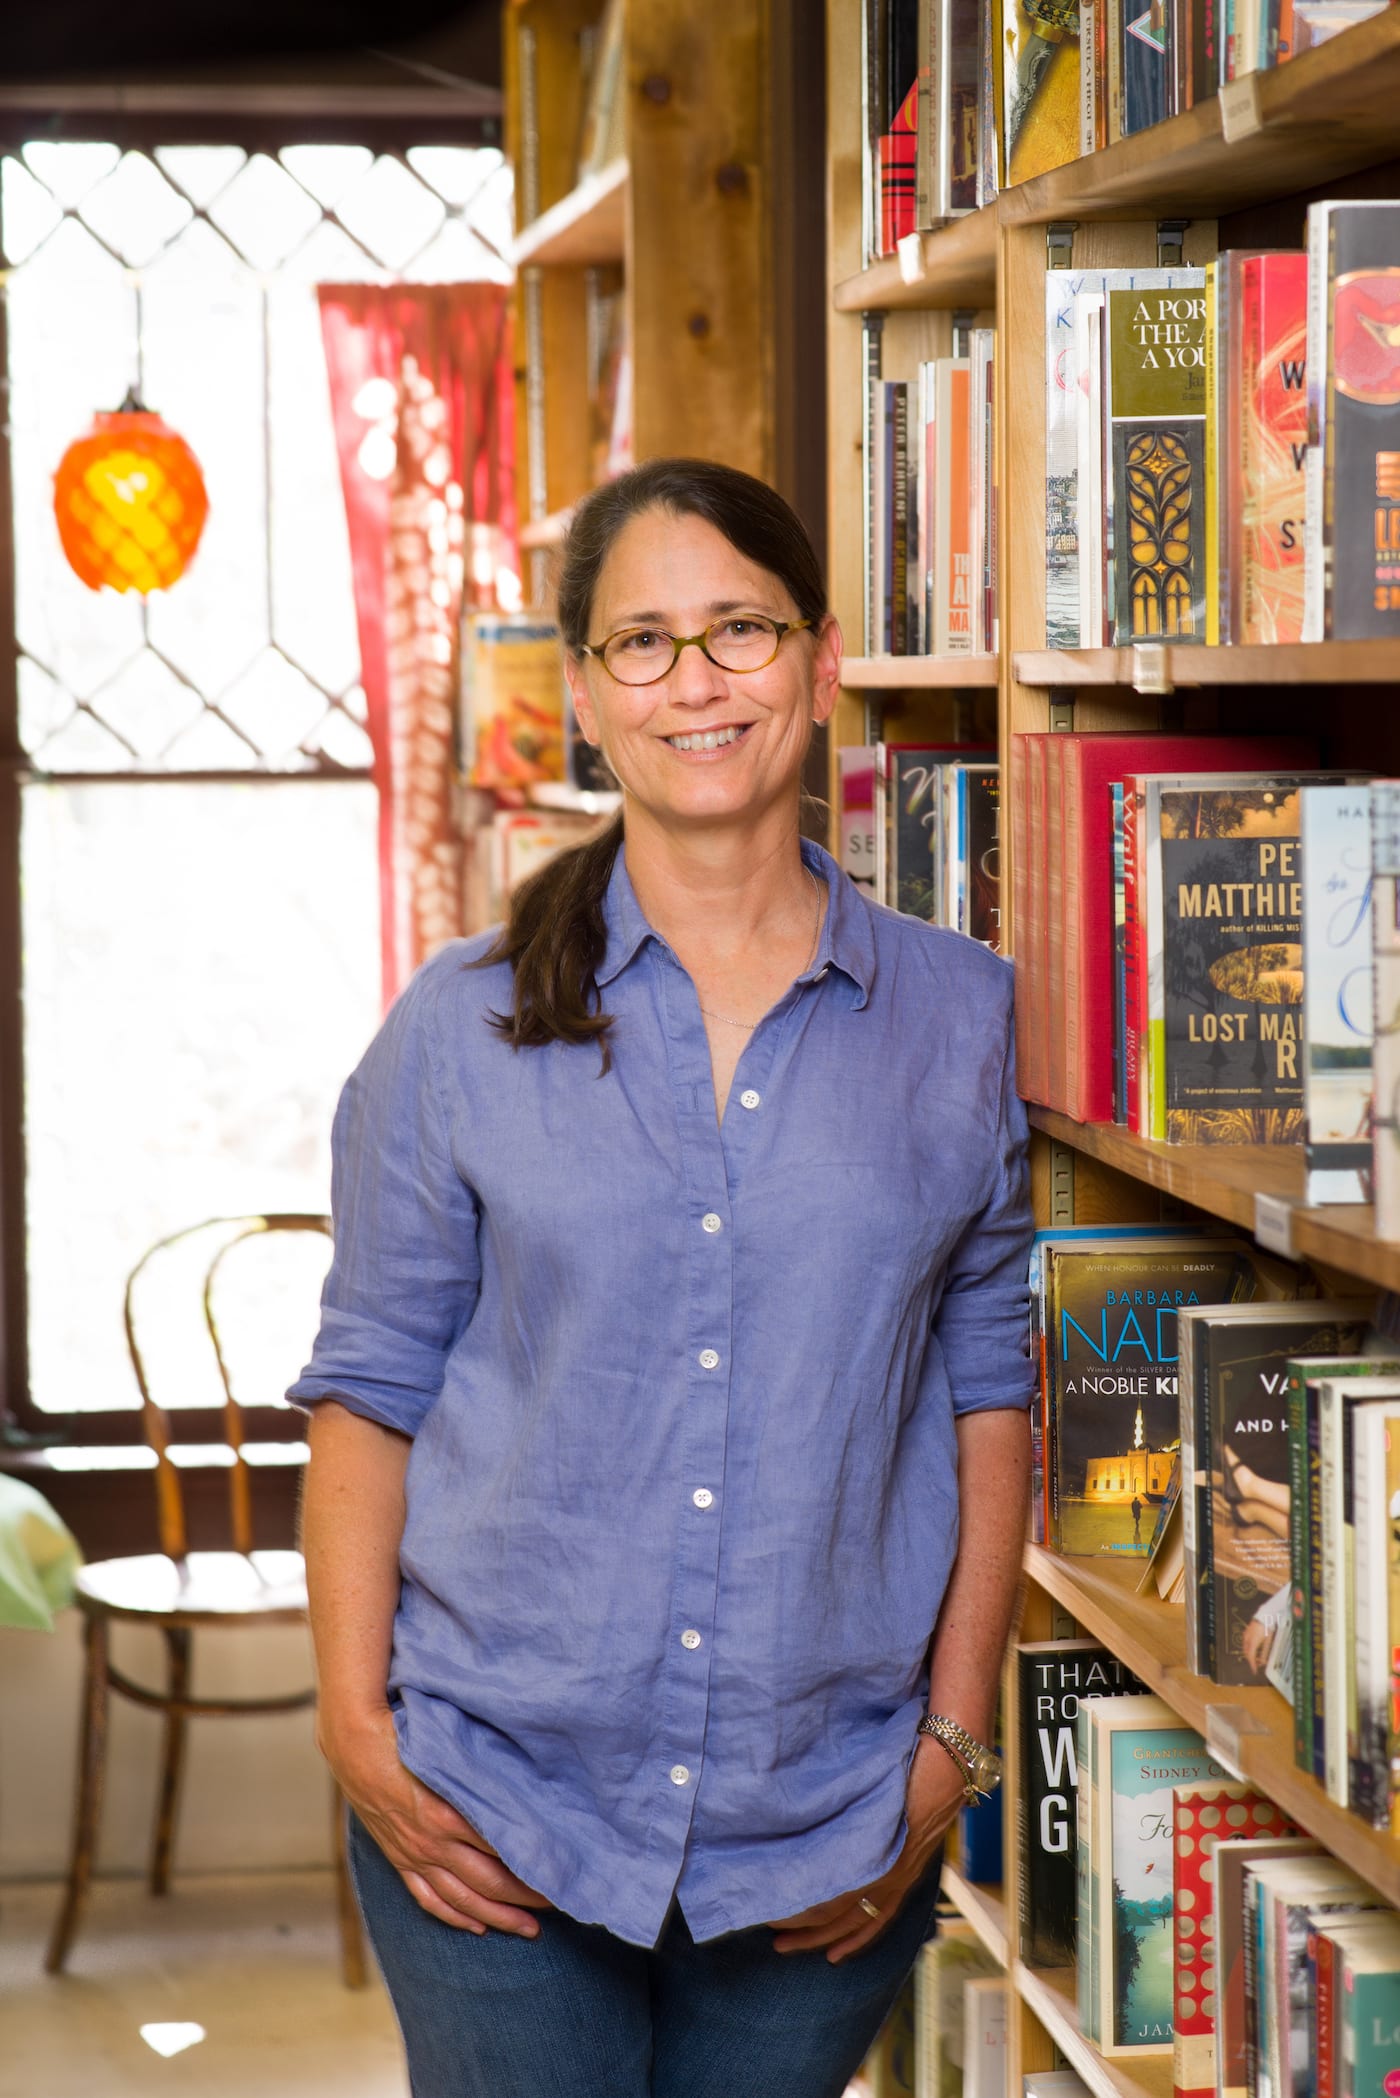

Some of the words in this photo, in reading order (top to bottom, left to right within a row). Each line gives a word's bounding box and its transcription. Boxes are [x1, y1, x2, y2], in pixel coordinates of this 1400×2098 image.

[1133, 301, 1151, 321] A
[1133, 323, 1190, 345] THE
[1141, 348, 1160, 368] A
[895, 397, 906, 443] PETER
[895, 450, 906, 520] BEHRENS
[1338, 806, 1371, 818] HA
[1220, 925, 1244, 933] author
[1246, 924, 1254, 932] of
[1256, 923, 1284, 932] KILLING
[1286, 923, 1302, 932] MIS
[1188, 1013, 1249, 1042] LOST
[1086, 1264, 1111, 1272] WHEN
[1113, 1264, 1148, 1272] HONOUR
[1151, 1264, 1169, 1272] CAN
[1171, 1264, 1180, 1272] BE
[1183, 1263, 1216, 1272] DEADLY
[1106, 1289, 1200, 1305] BARBARA
[1066, 1379, 1078, 1394] A
[1082, 1377, 1148, 1395] NOBLE
[1234, 1419, 1274, 1433] AND
[1140, 1765, 1200, 1779] SIDNEY
[1017, 1860, 1027, 1923] GINGER
